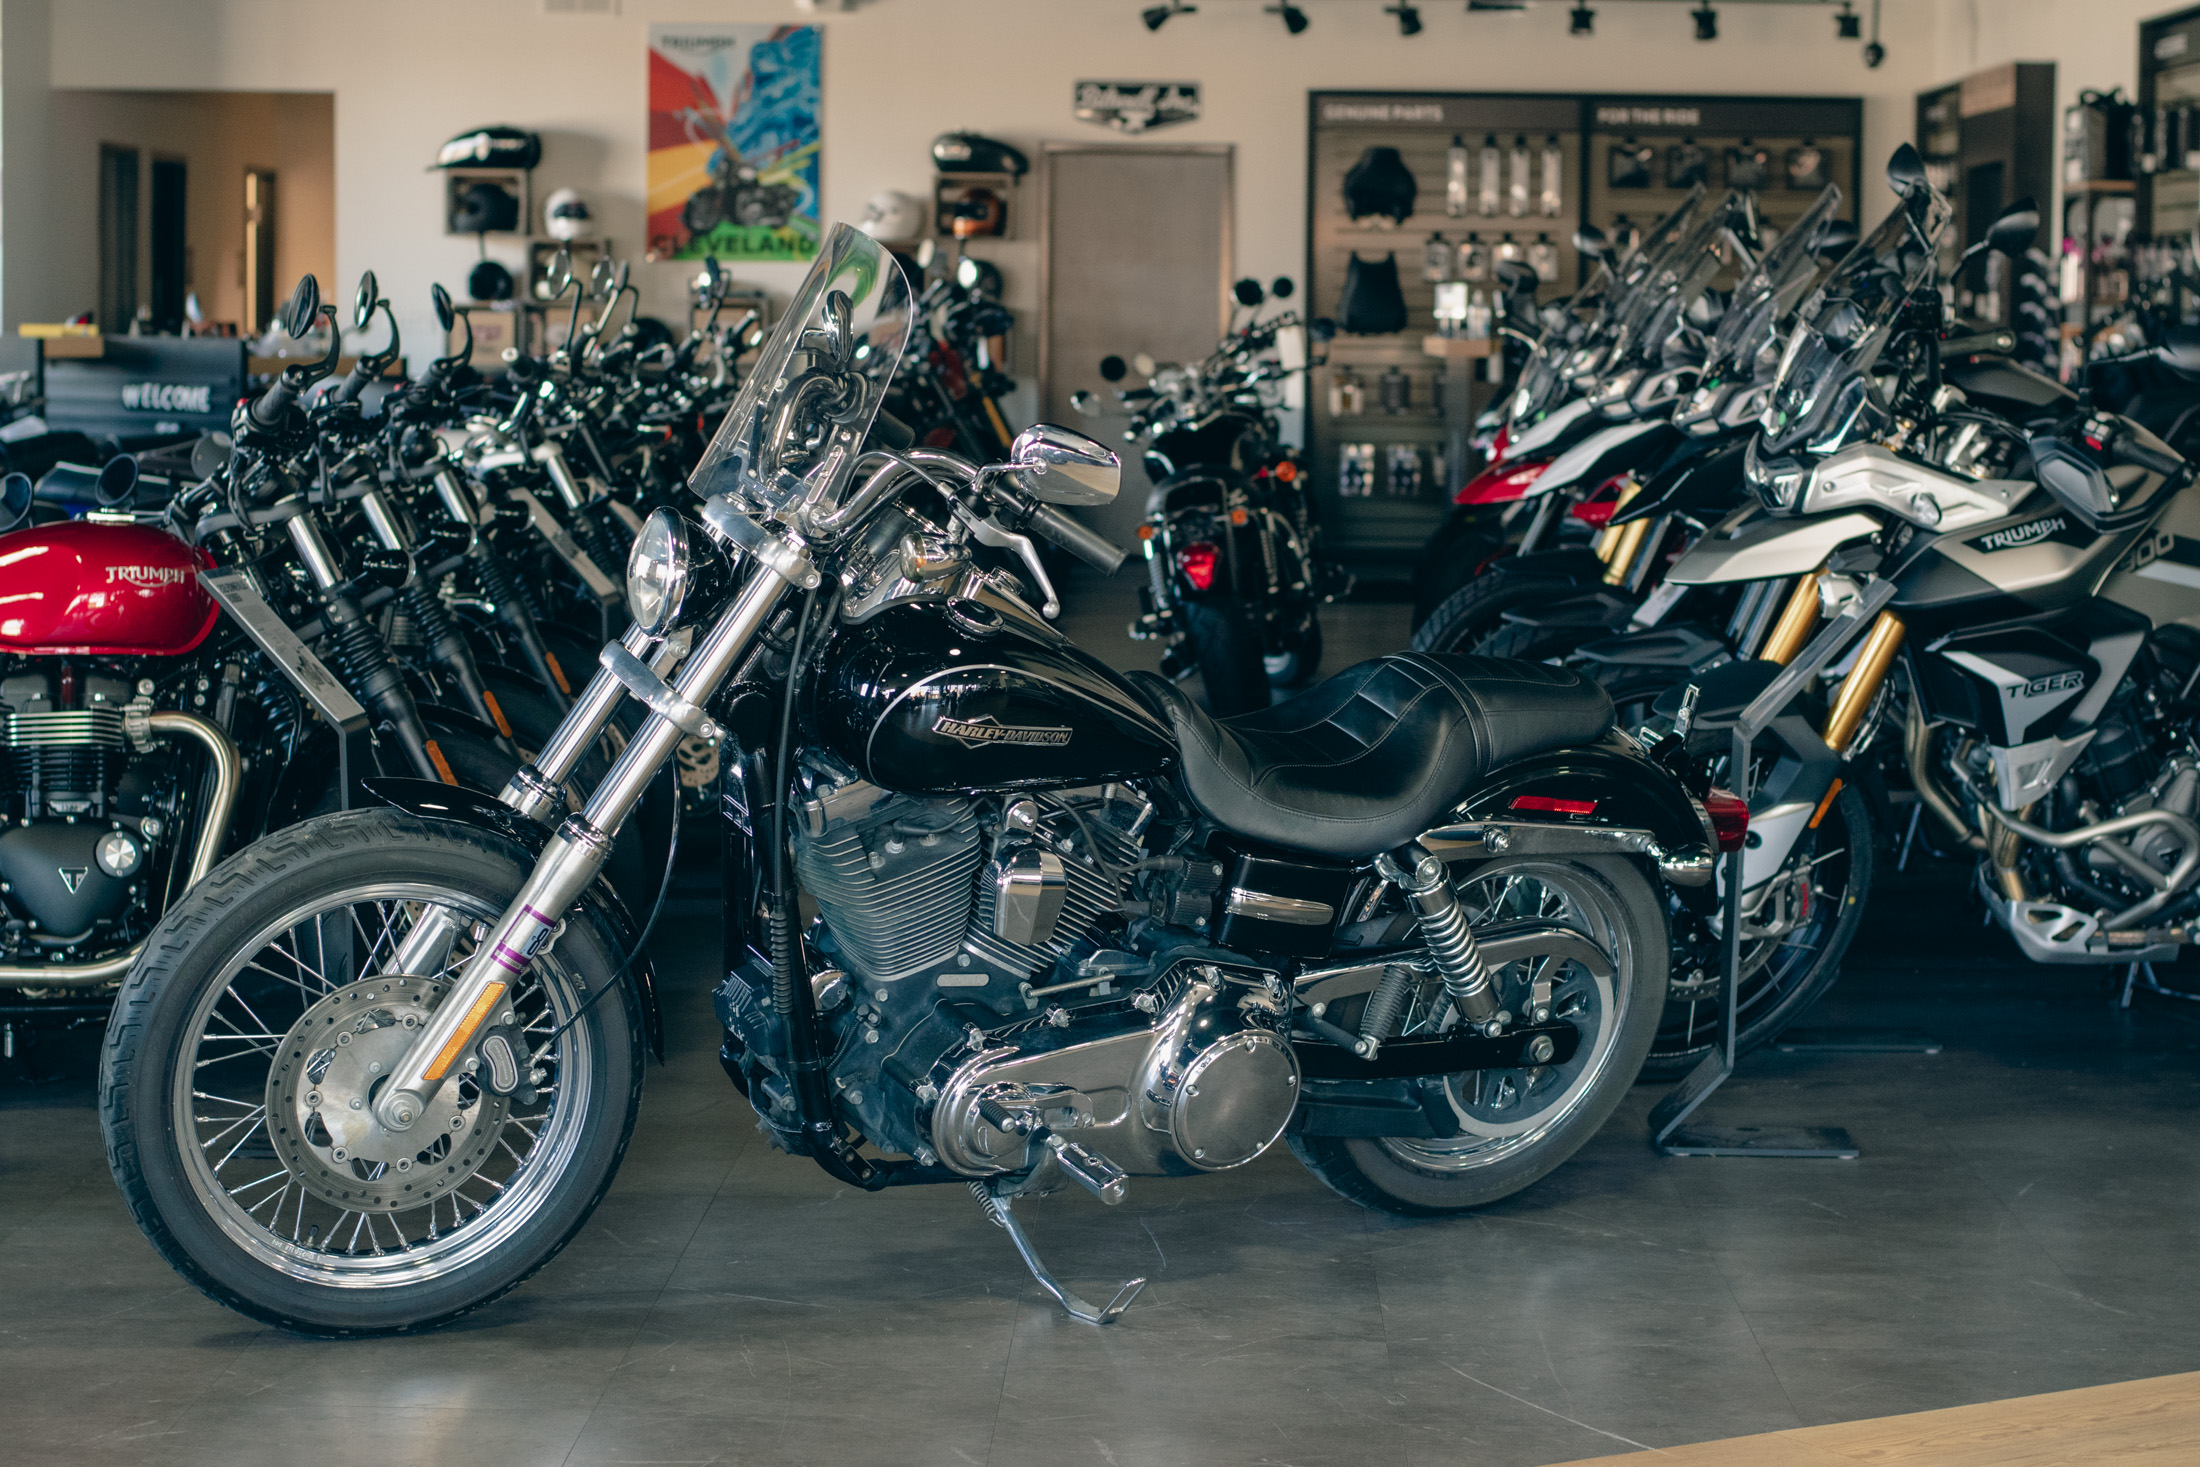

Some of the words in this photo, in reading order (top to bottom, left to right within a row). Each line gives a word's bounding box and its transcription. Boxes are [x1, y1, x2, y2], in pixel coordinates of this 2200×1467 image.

[661, 35, 736, 50] TRIUMPH
[1393, 104, 1444, 122] PARTS
[1597, 107, 1630, 124] FOR
[1631, 107, 1660, 125] THE
[1663, 107, 1700, 126] RIDE
[652, 234, 815, 256] CLEVELAND
[122, 383, 211, 413] WELCOME
[1981, 517, 2067, 550] TRIUMPH
[105, 565, 185, 588] TRIUMPH
[2006, 670, 2085, 698] TIGER
[940, 721, 1069, 743] HARLEY-DAVIDSON
